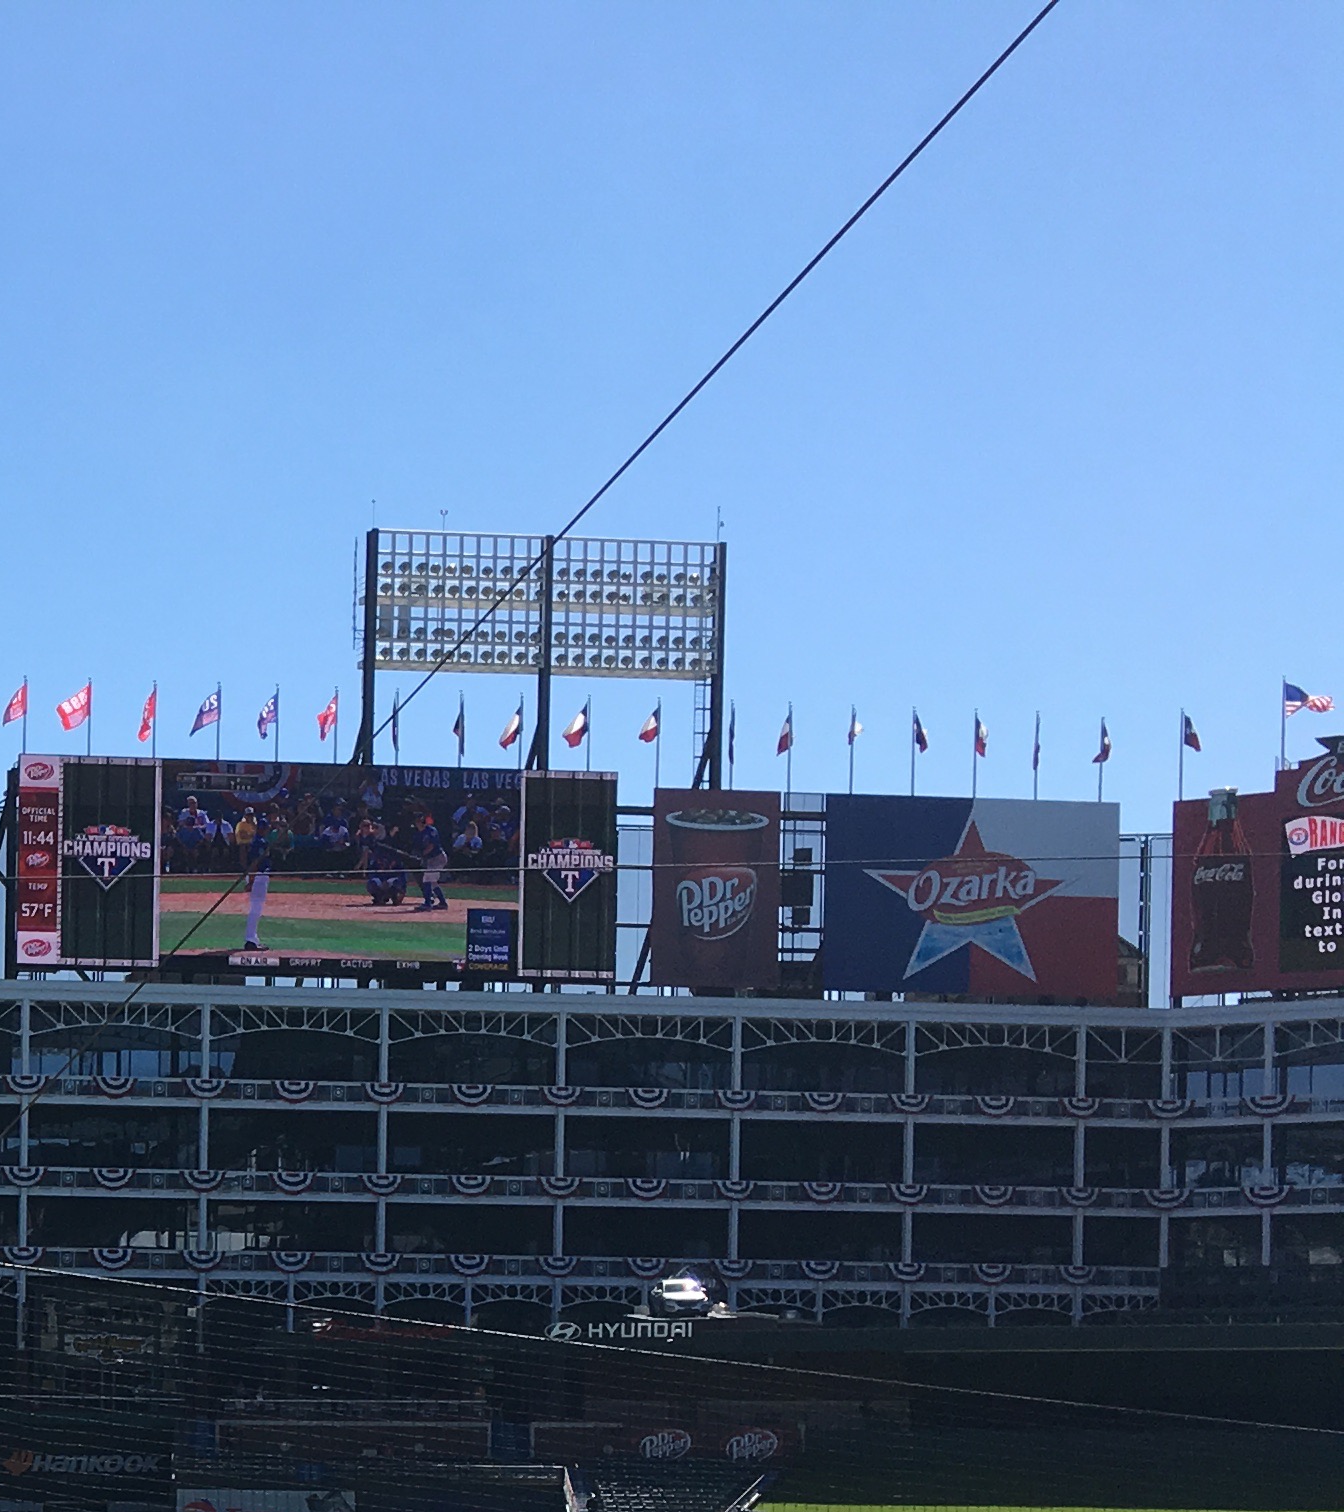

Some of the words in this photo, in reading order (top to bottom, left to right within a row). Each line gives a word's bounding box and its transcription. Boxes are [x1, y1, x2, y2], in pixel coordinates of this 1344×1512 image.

[404, 770, 450, 789] VEGAS
[463, 771, 489, 789] LAS
[22, 807, 56, 816] OFFICIAL
[29, 815, 48, 823] TIME
[23, 831, 54, 845] 11:44
[64, 841, 151, 858] CHAMPIONS
[528, 854, 614, 870] CHAMPIONS
[702, 876, 739, 901] Dr
[907, 865, 1036, 911] Ozarka
[1294, 873, 1344, 889] durin
[678, 881, 754, 932] Pepper
[1323, 907, 1342, 919] In
[1305, 925, 1343, 938] text
[1319, 940, 1336, 952] to
[341, 960, 372, 969] CACTUS
[588, 1322, 693, 1338] HYUNDAI
